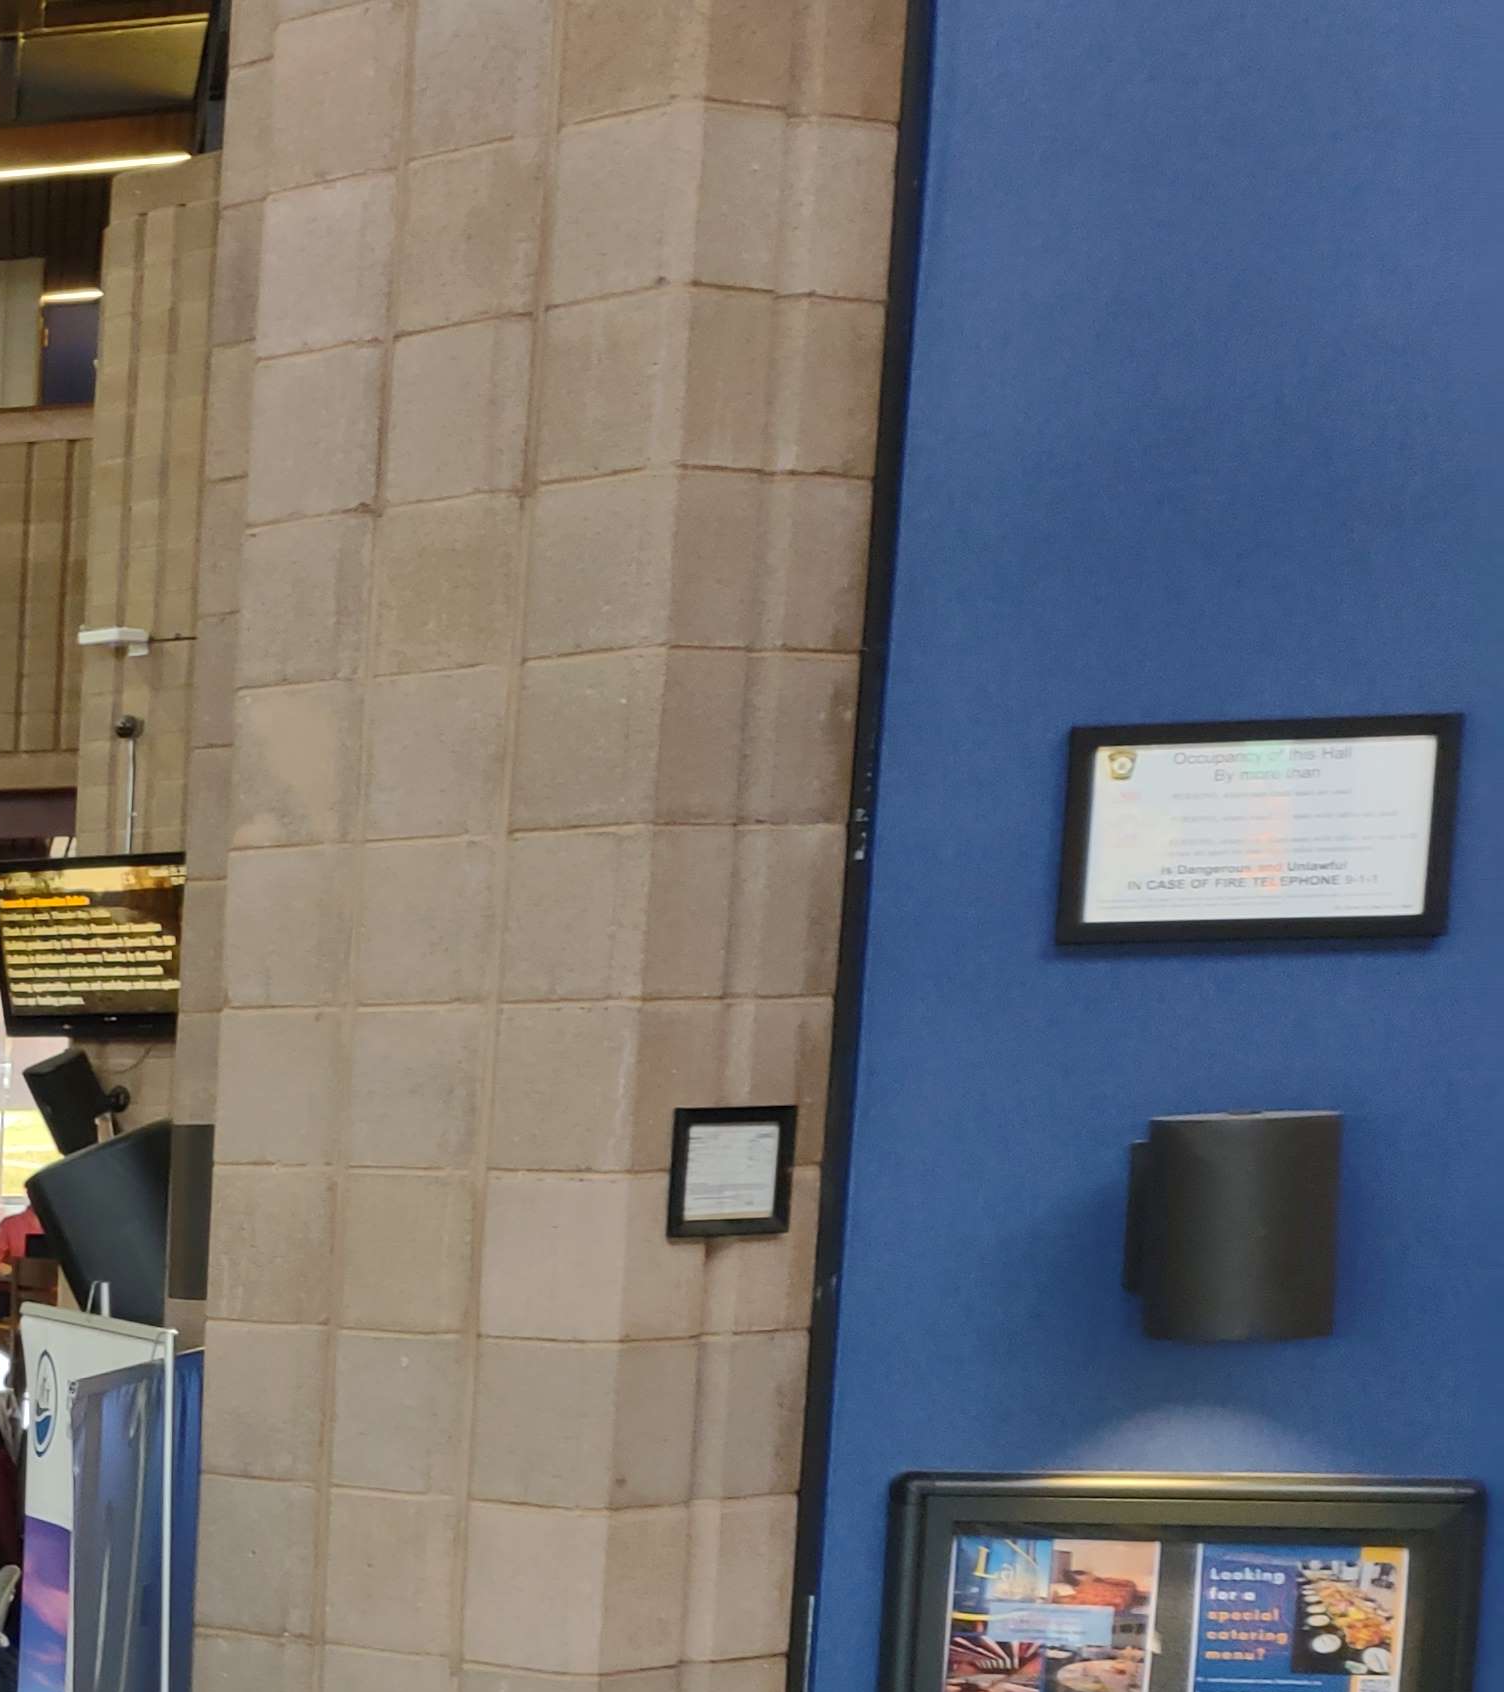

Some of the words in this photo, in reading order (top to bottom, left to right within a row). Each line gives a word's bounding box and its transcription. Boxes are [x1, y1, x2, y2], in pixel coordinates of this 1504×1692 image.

[1210, 1567, 1286, 1585] Looking
[1208, 1586, 1238, 1601] for
[1241, 1590, 1257, 1601] a
[1207, 1608, 1281, 1623] special
[1205, 1628, 1289, 1645] catering
[1204, 1648, 1266, 1660] menu?
